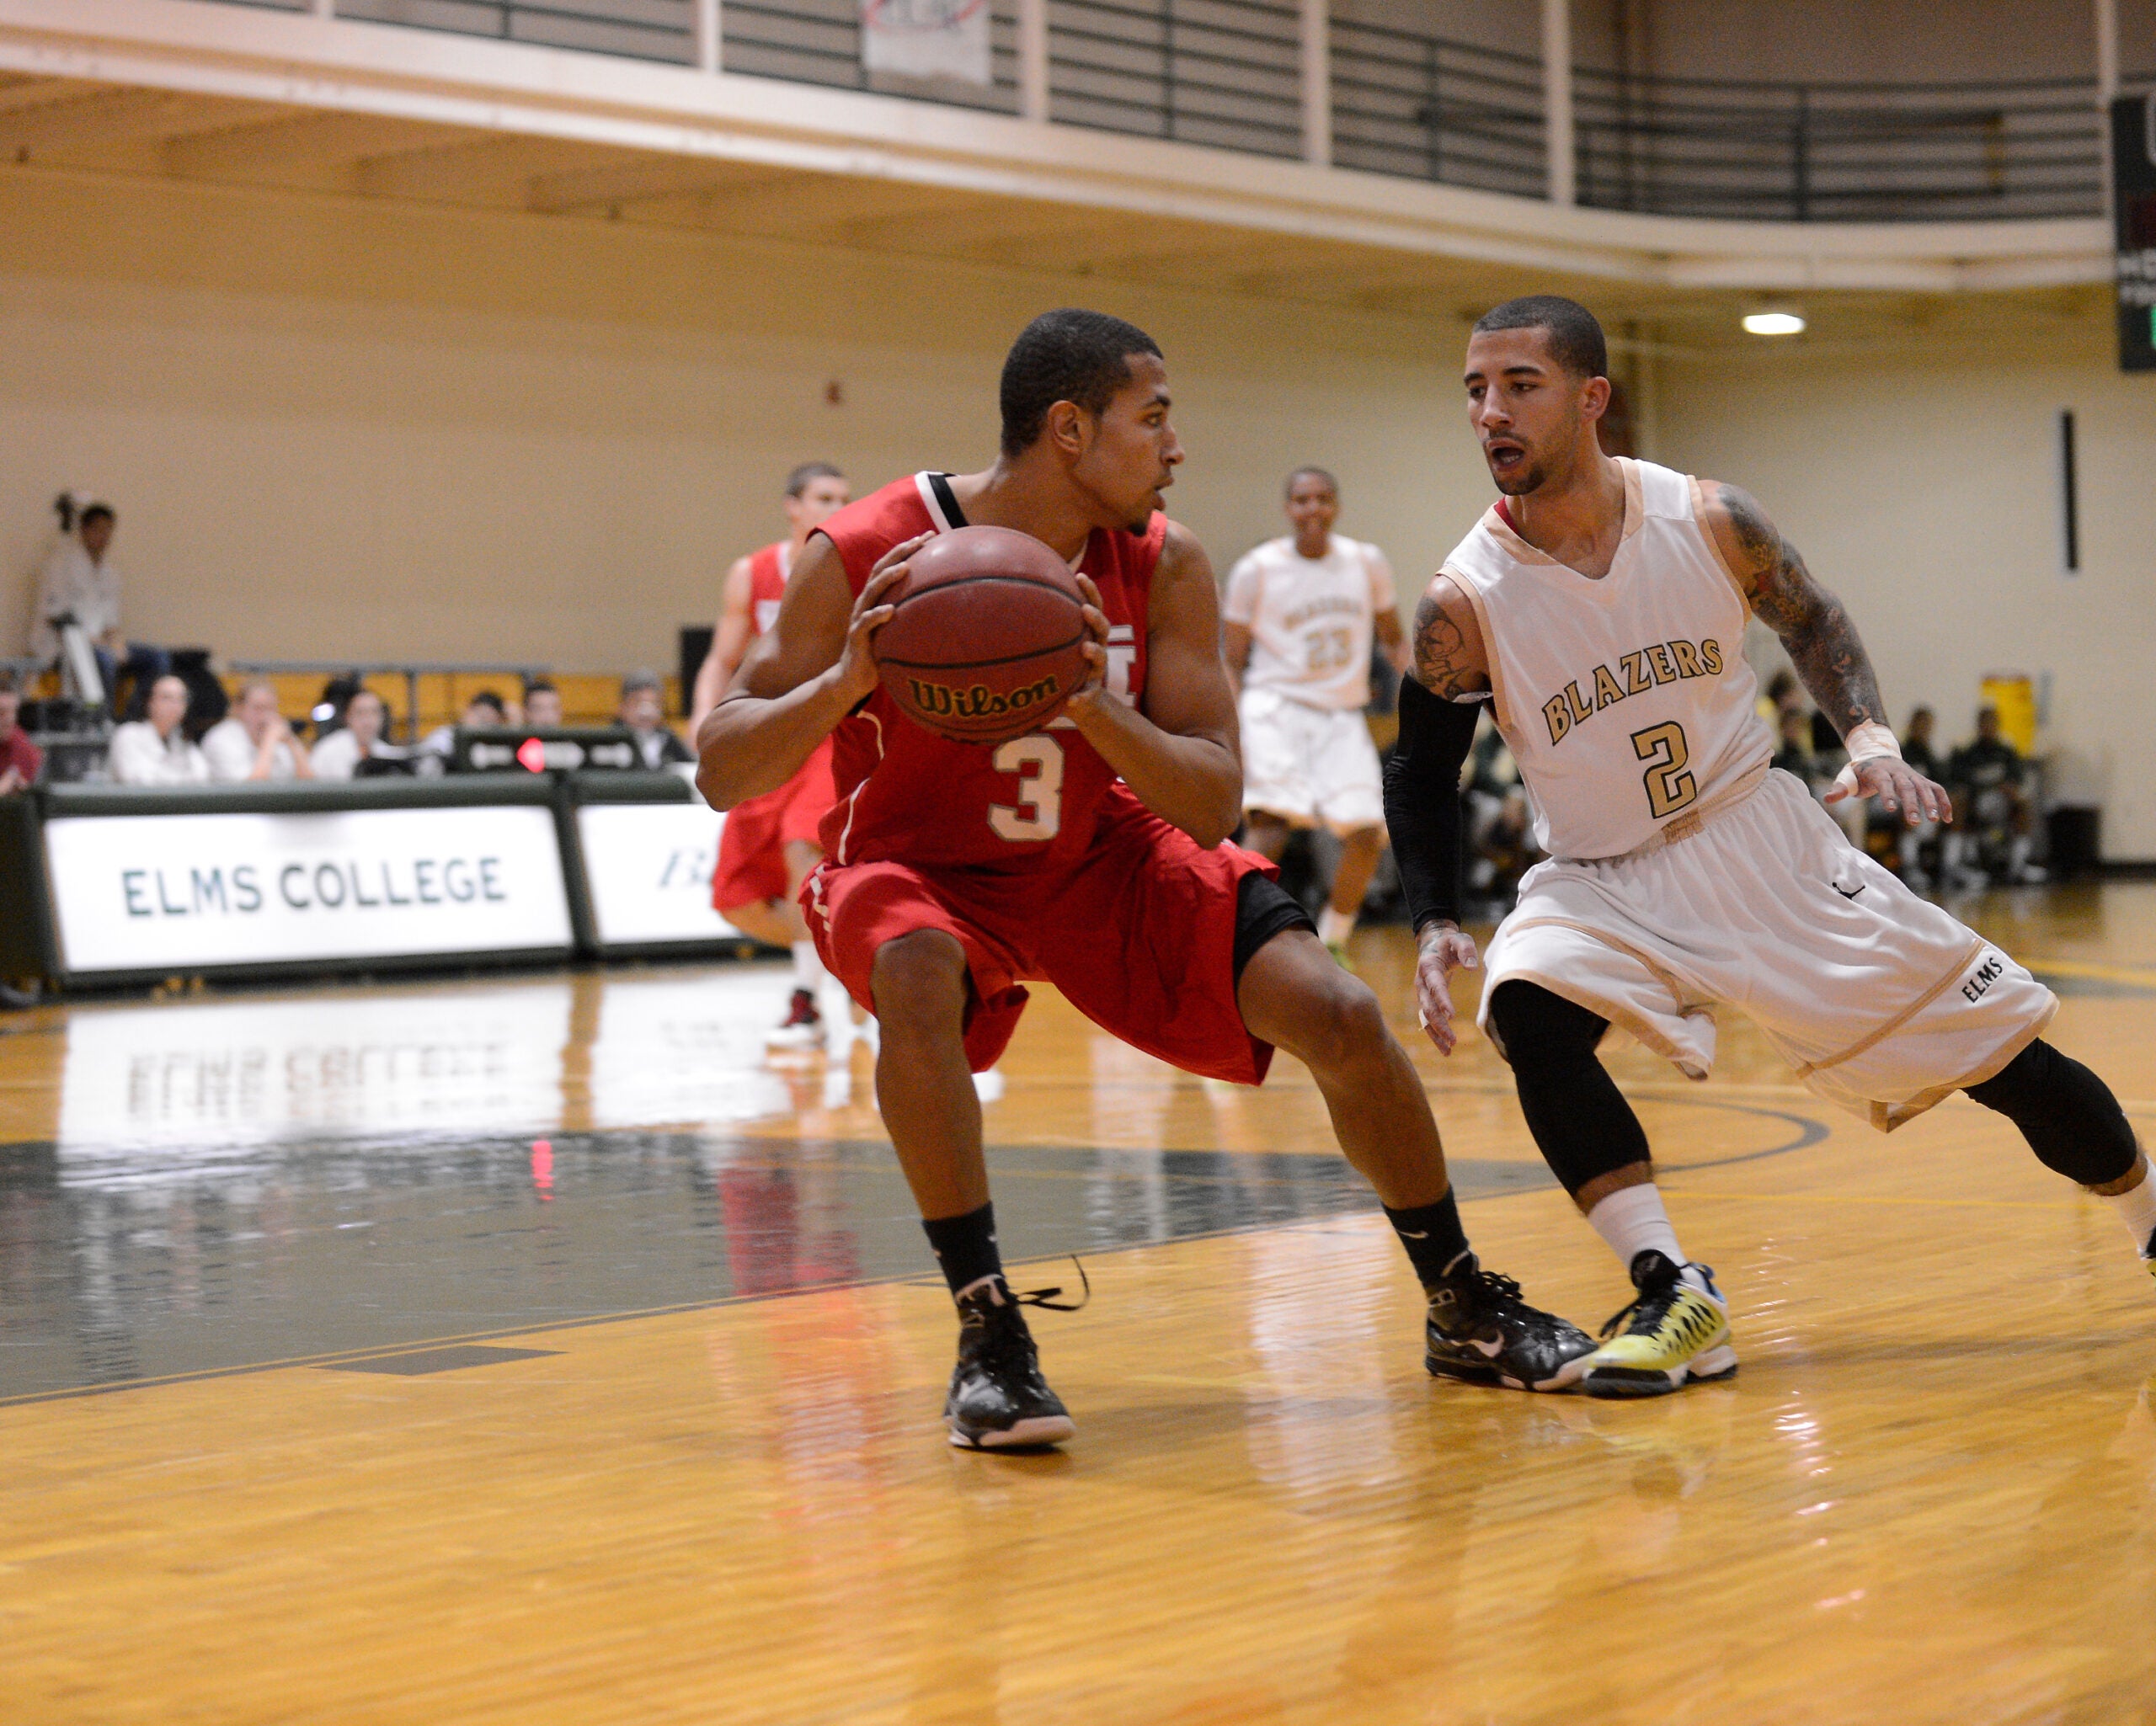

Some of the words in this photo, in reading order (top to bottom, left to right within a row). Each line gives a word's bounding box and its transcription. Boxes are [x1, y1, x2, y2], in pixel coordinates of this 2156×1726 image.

[908, 674, 1059, 717] Wilson
[1541, 638, 1724, 747] BLAZERS
[986, 732, 1065, 842] 3
[1629, 720, 1698, 819] 2
[122, 866, 262, 918] ELMS
[280, 857, 507, 909] COLLEGE
[1961, 956, 2003, 1004] ELMS
